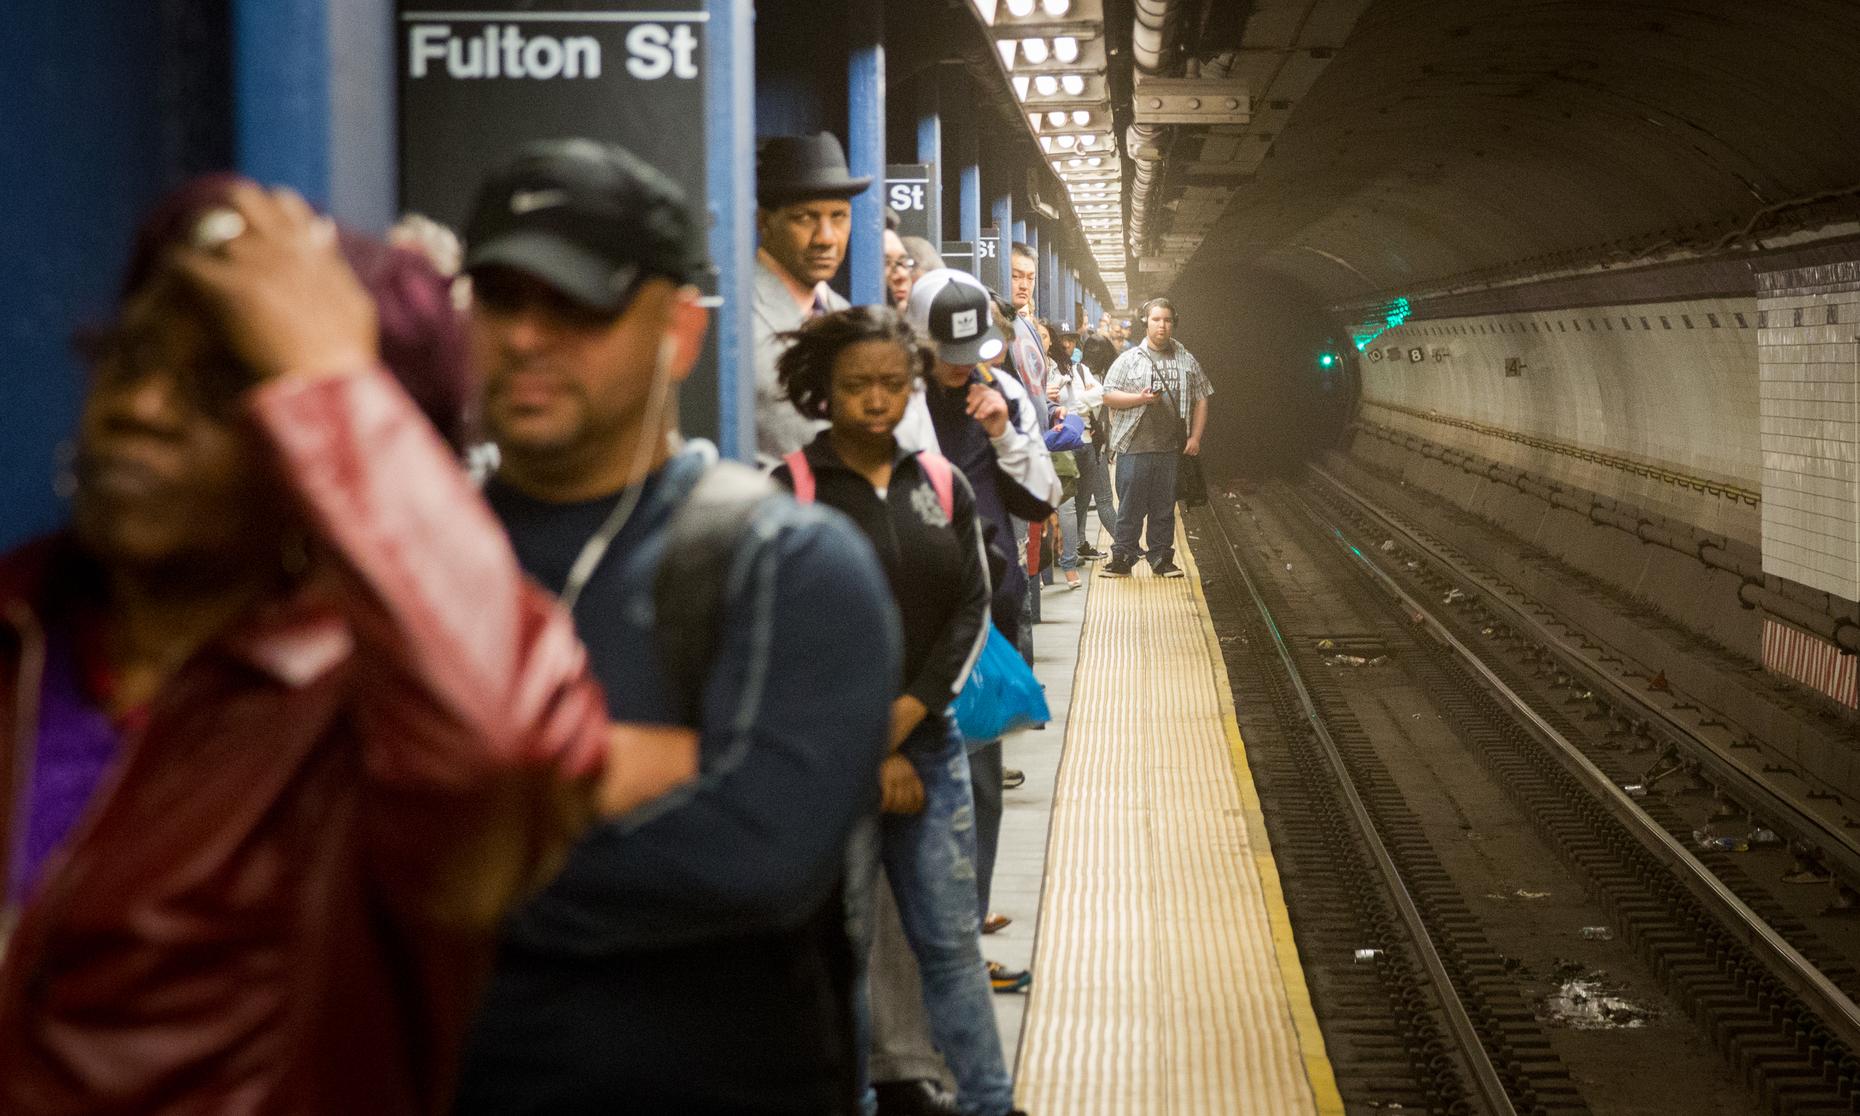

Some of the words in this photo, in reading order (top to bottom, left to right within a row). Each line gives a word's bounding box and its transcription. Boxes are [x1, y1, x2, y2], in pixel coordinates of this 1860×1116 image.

[408, 24, 602, 79] Fulton
[625, 23, 698, 80] St
[890, 184, 924, 211] St
[1411, 349, 1421, 361] 8
